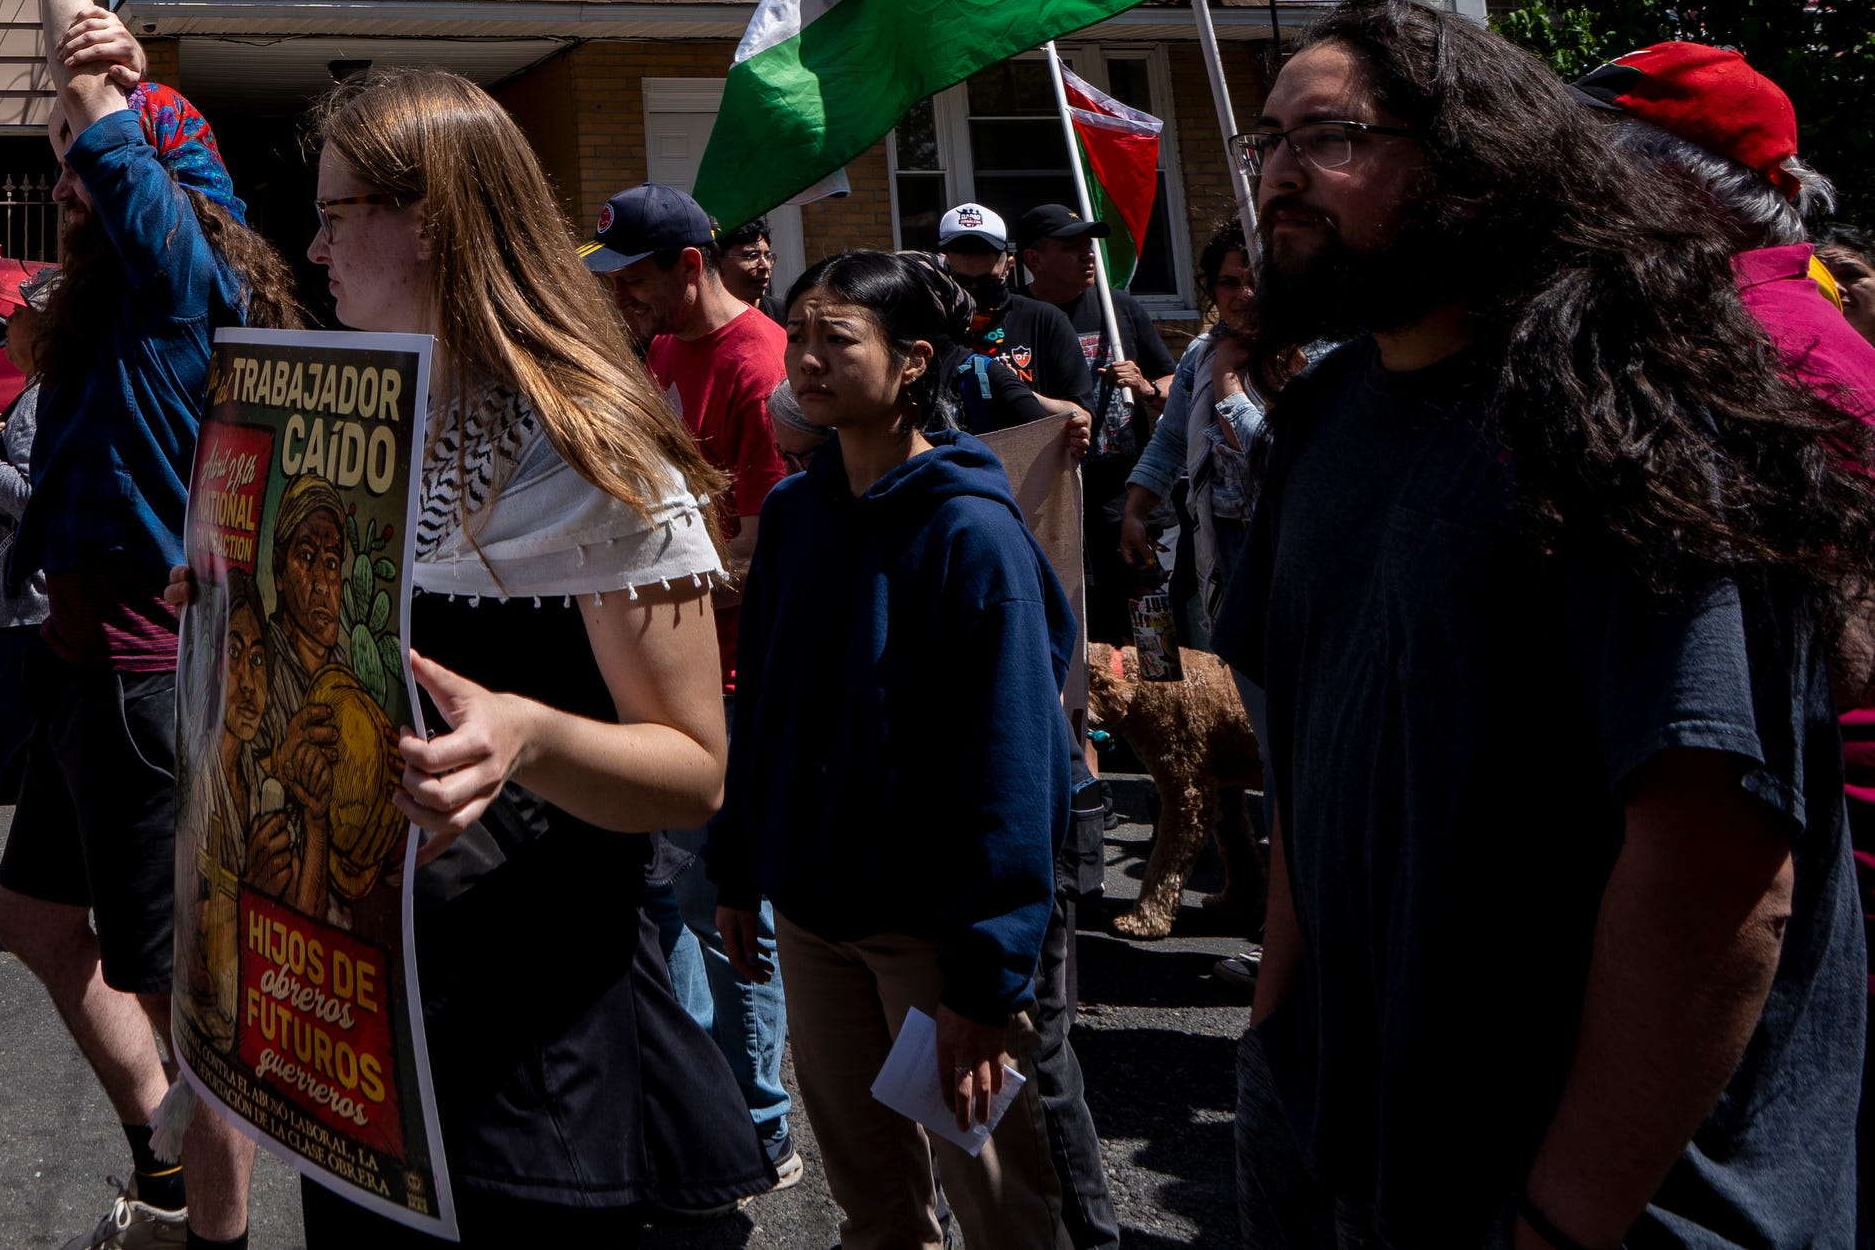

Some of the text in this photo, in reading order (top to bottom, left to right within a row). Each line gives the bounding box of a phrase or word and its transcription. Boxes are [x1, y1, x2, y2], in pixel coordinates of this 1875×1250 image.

[232, 357, 403, 422] TRABAJADOR
[225, 452, 258, 497] 28th
[281, 414, 397, 494] CAÍDO
[197, 488, 256, 532] NATIONAL
[217, 532, 253, 563] ACTION
[248, 910, 378, 1014] HIJOS DE
[260, 962, 356, 1030] obreros
[246, 986, 386, 1103] FUTUROS
[203, 1045, 237, 1088] CONTRA
[238, 1074, 250, 1097] EL
[290, 1110, 356, 1162] LABORAL,
[358, 1147, 380, 1173] LA
[255, 1048, 369, 1127] guerreros
[255, 1105, 268, 1128] DE
[270, 1117, 286, 1141] LA
[287, 1129, 325, 1162] CLASE
[327, 1153, 392, 1197] OBRERA
